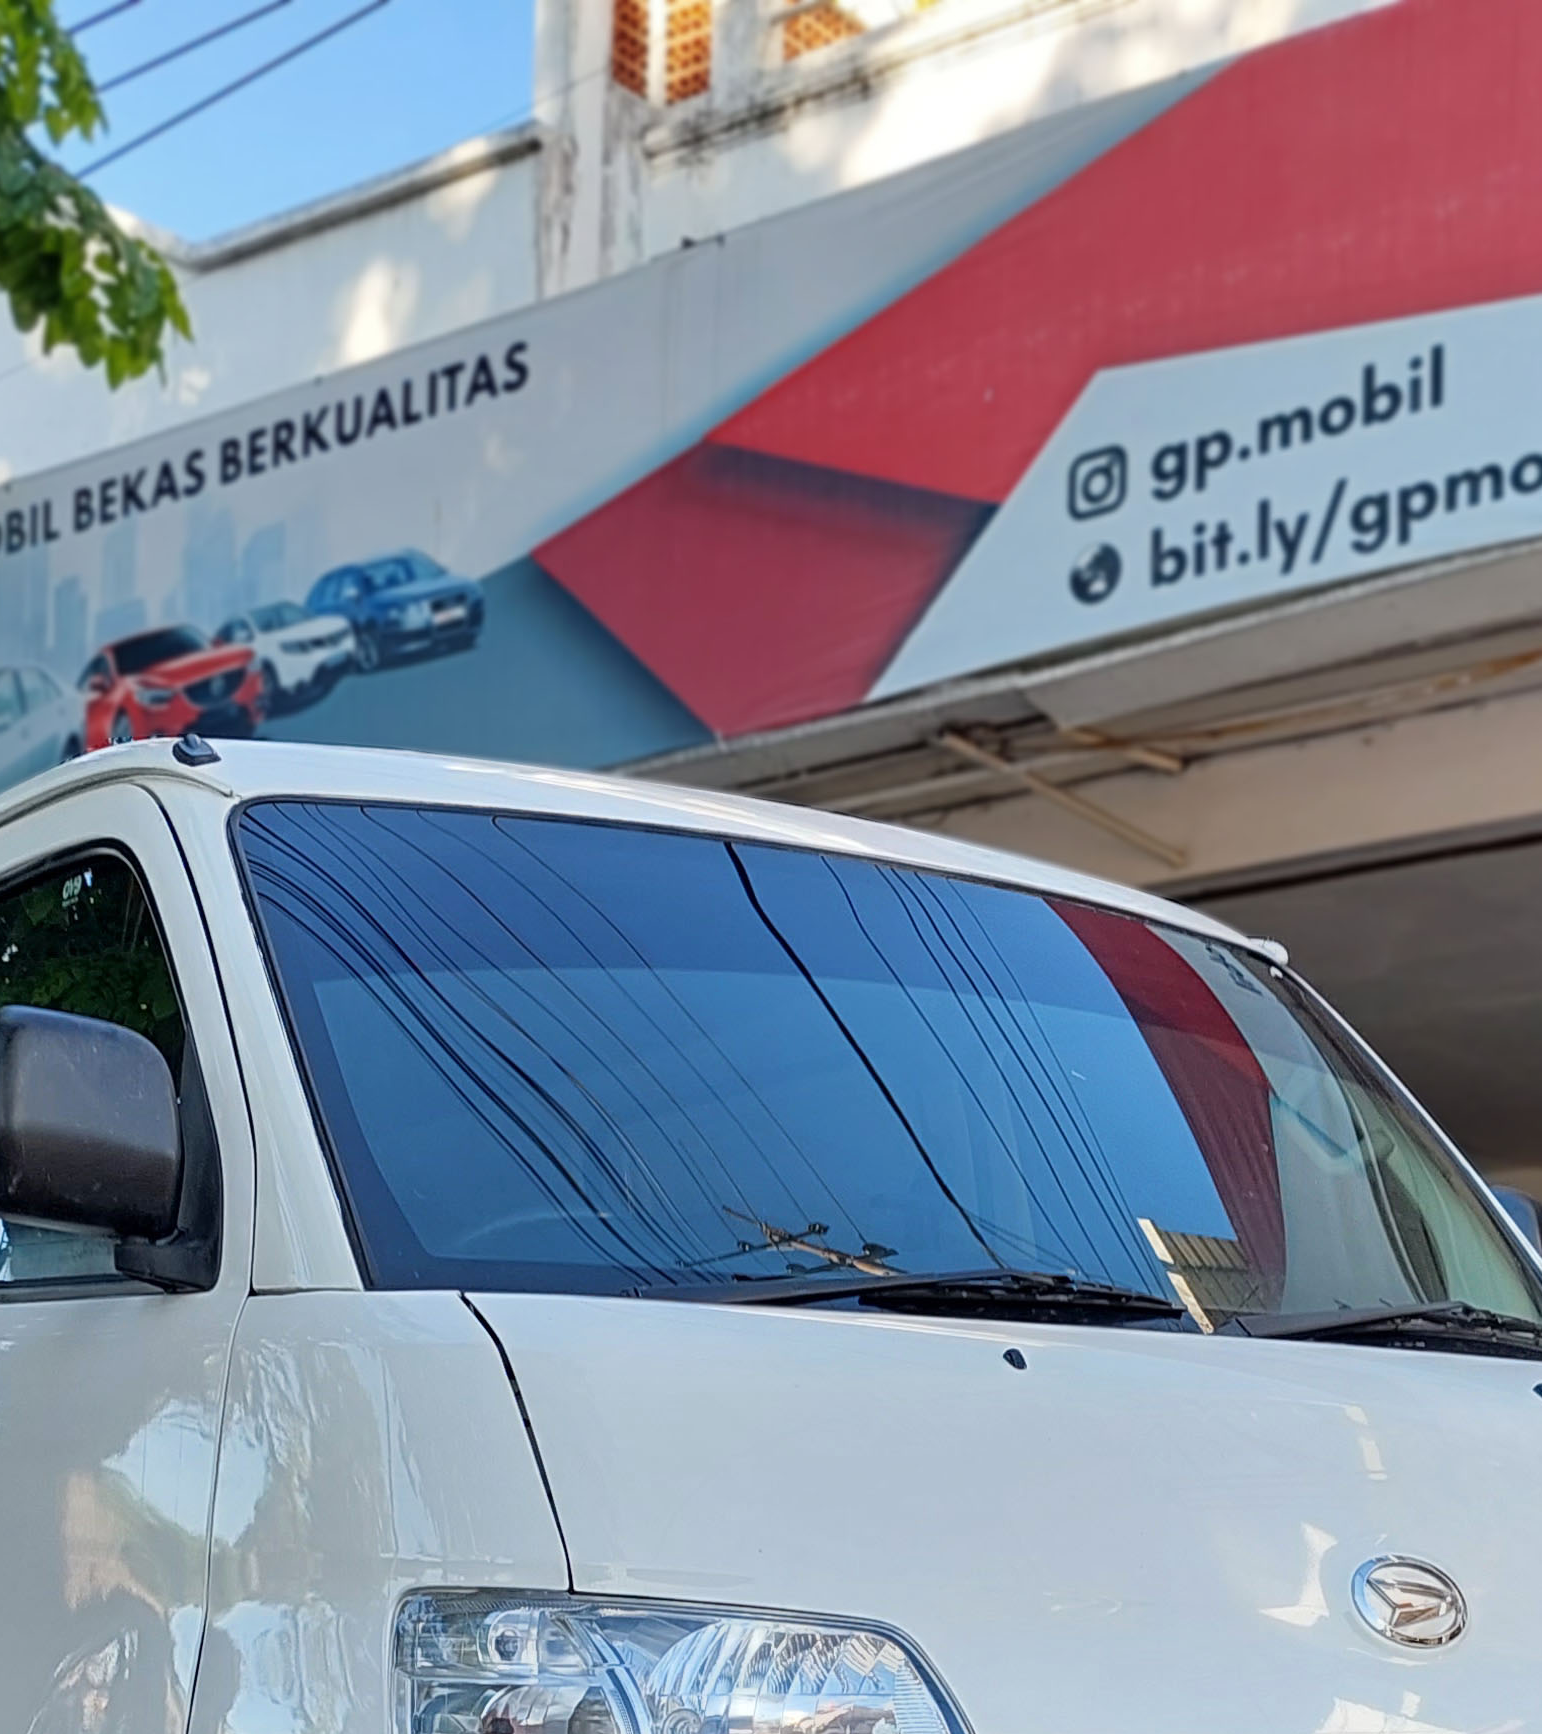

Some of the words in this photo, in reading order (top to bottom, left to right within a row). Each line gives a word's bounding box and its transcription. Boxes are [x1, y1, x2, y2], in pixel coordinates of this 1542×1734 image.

[71, 448, 207, 534] BEKAS
[218, 340, 531, 486] BERKUALITAS
[1150, 343, 1446, 502] gp.mobil
